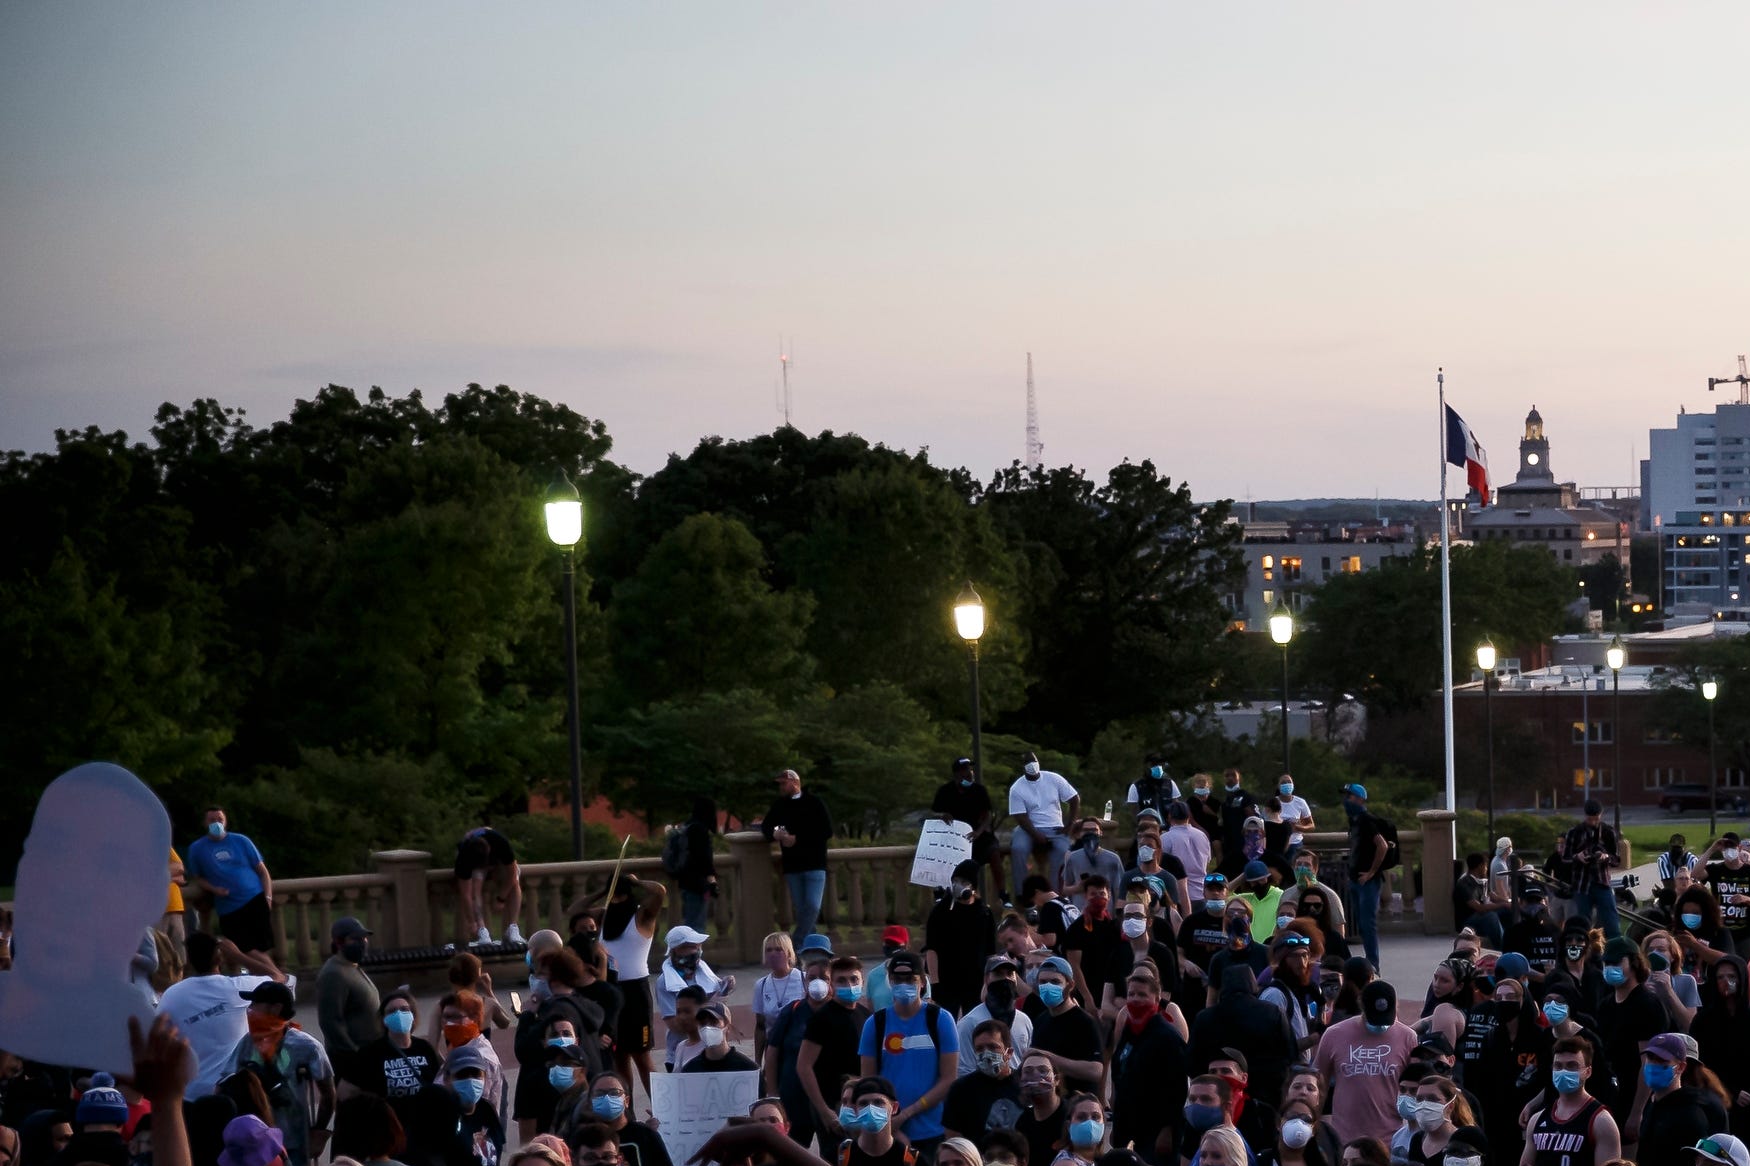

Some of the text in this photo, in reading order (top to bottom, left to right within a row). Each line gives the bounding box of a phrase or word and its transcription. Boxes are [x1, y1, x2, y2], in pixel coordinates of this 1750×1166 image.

[1719, 905, 1748, 918] EOPLE
[1349, 1044, 1391, 1063] KEEP
[386, 1077, 422, 1088] RACIA
[1533, 1132, 1585, 1152] PORTLAND
